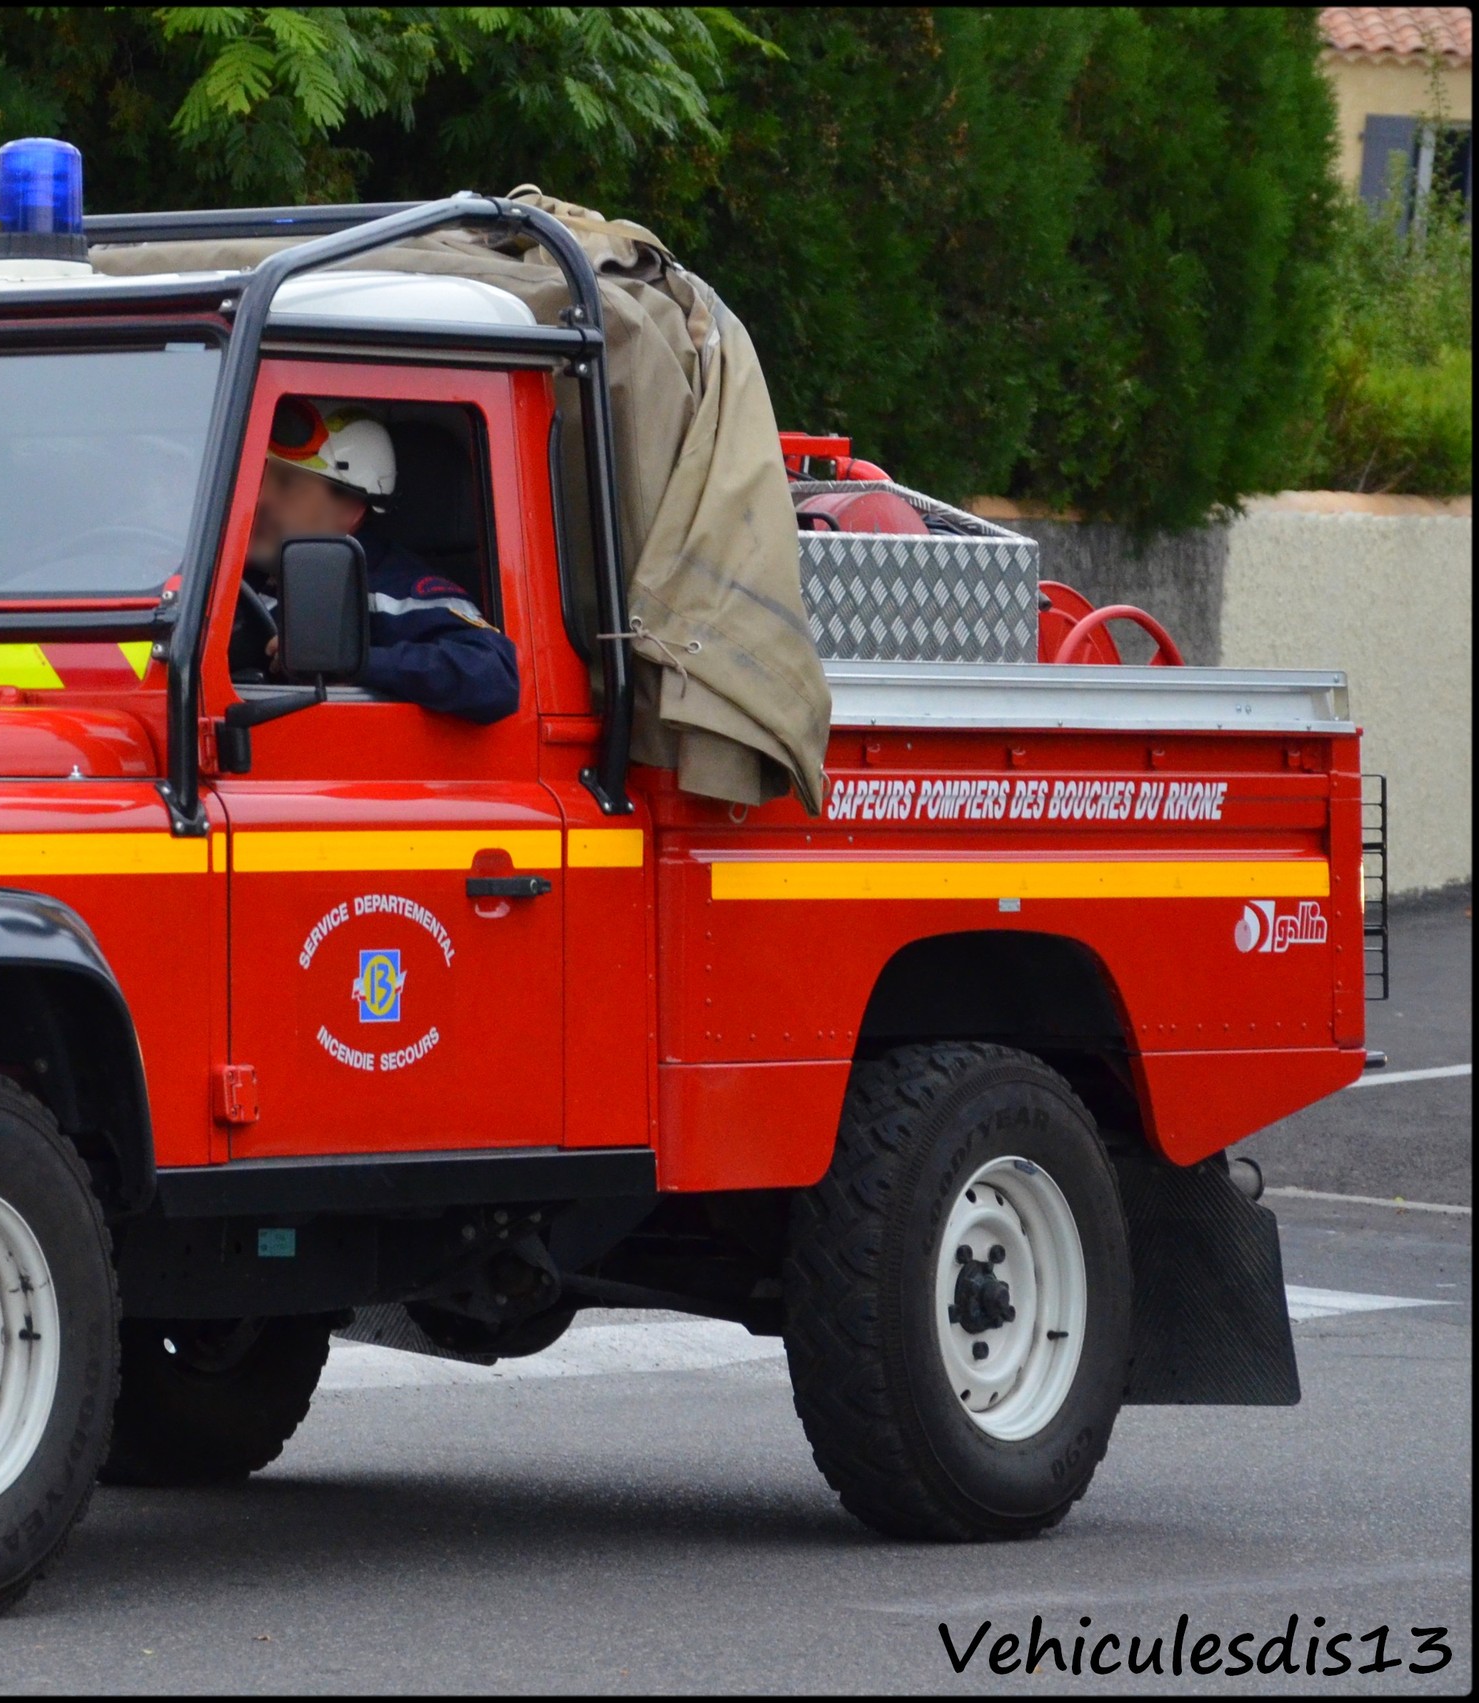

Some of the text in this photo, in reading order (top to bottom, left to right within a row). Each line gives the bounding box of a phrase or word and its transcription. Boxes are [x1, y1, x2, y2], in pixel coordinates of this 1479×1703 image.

[827, 780, 1228, 820] SAPEURS POMPIERS DES BOUCHES DU RHONE
[299, 894, 456, 970] SERVICE DEPARTEMENTAL
[316, 1025, 440, 1071] INCENDIE SECOURS
